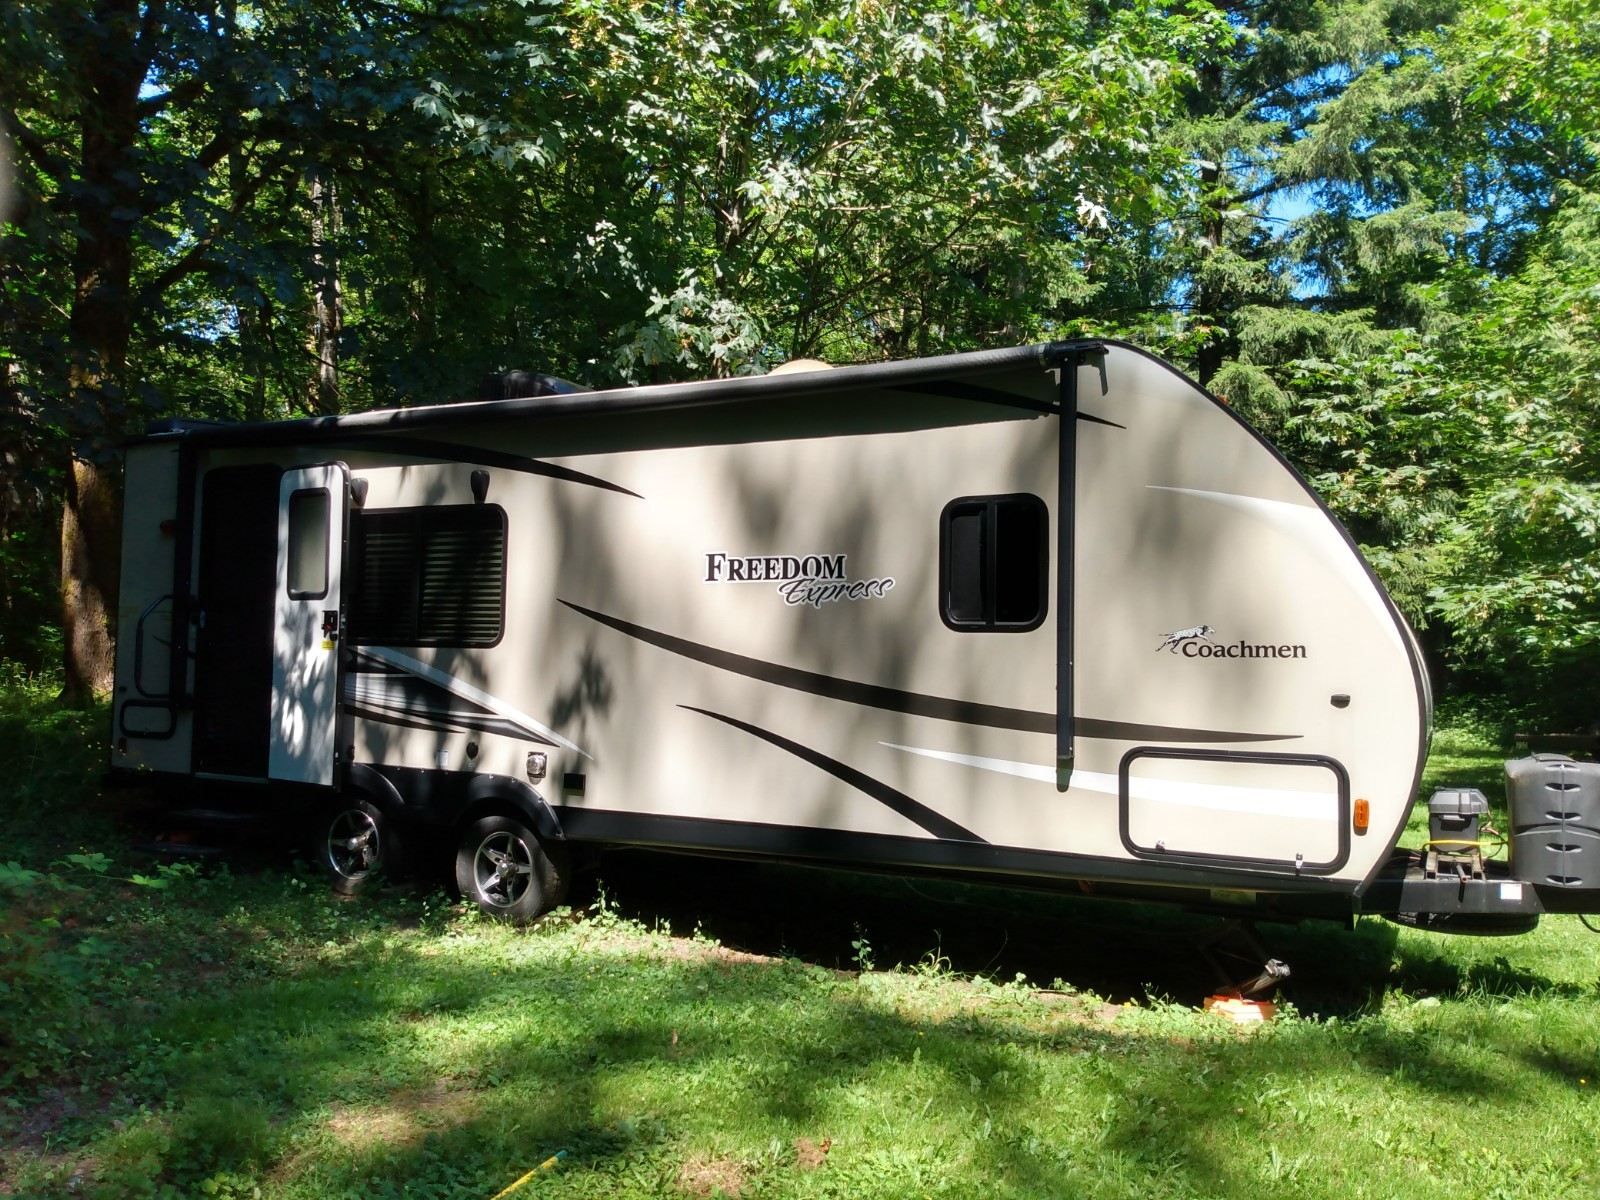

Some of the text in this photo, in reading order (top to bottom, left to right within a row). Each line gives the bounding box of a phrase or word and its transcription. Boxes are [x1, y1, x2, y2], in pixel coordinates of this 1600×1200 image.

[705, 553, 846, 582] FREEDOM
[778, 578, 894, 607] Express
[1182, 640, 1307, 659] Coachmen
